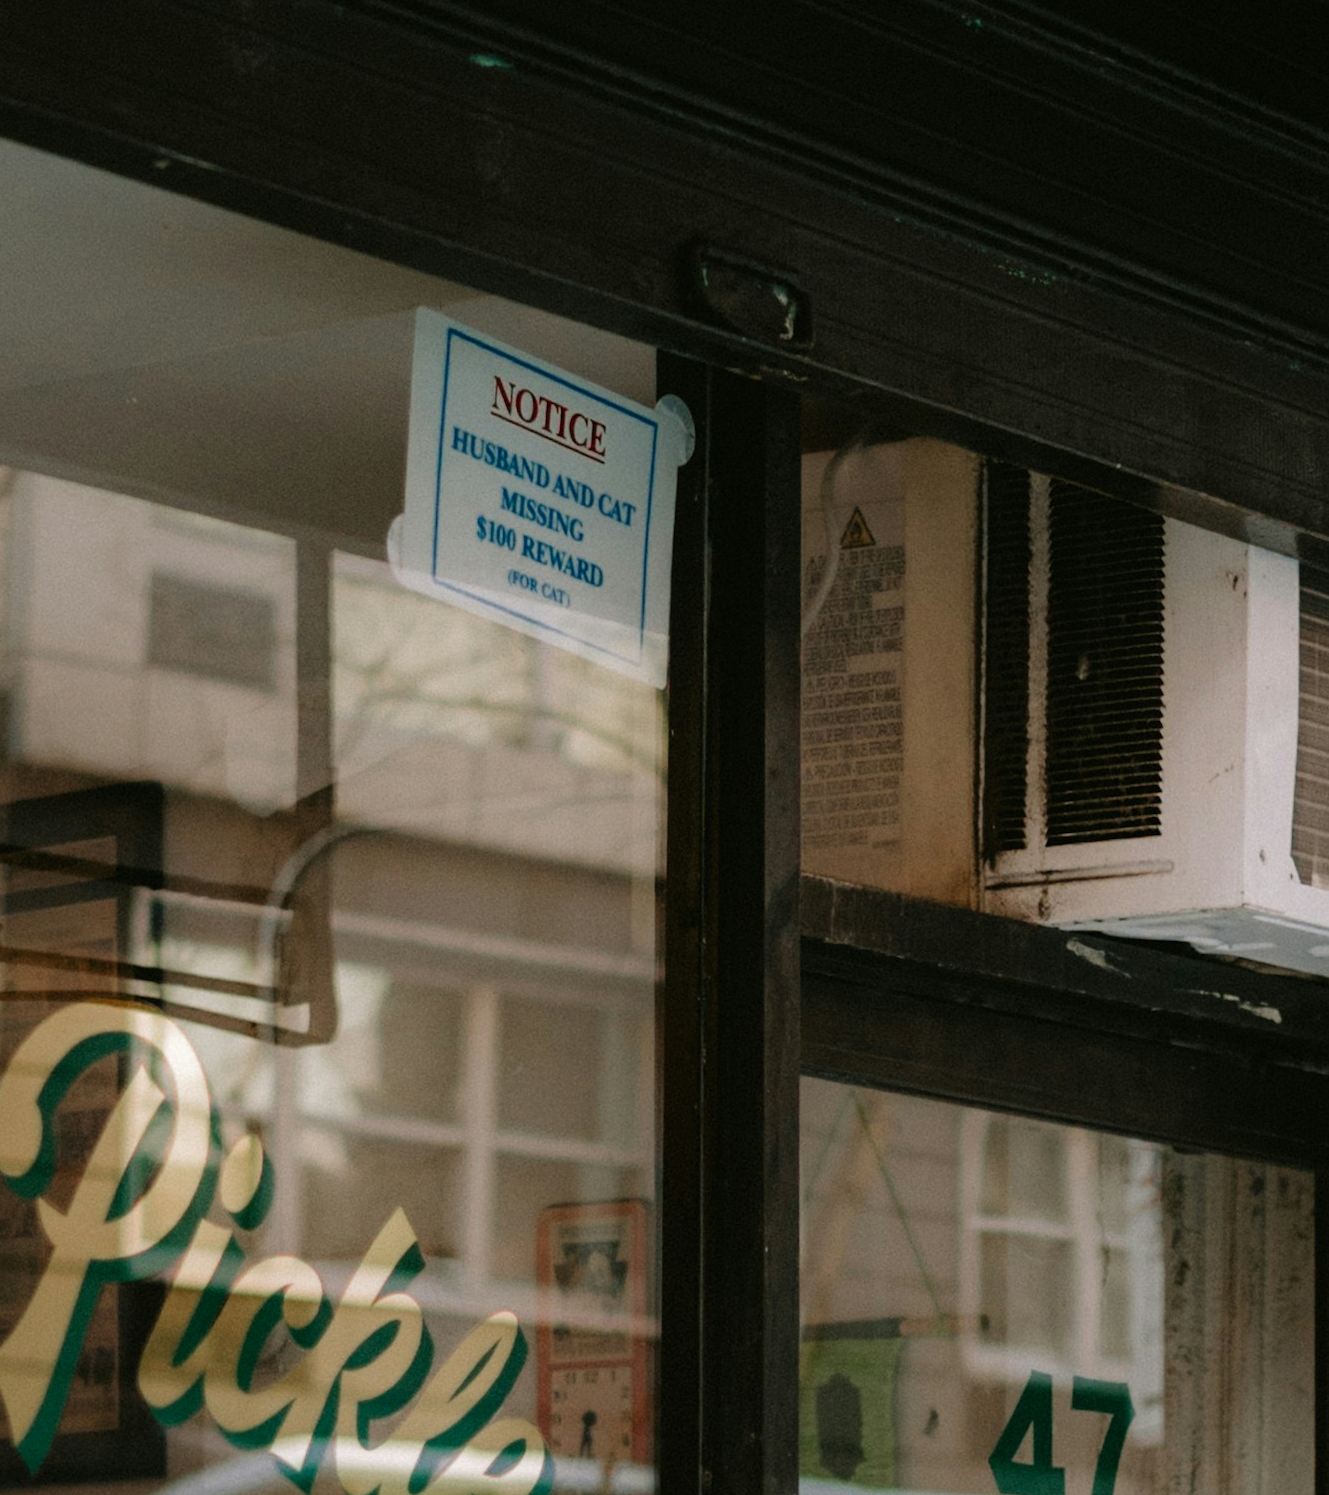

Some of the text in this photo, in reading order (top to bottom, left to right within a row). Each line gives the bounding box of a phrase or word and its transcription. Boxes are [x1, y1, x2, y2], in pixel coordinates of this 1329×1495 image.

[491, 376, 607, 458] NOTICE
[452, 426, 636, 527] HUSBAND AND CAT
[500, 487, 585, 542] MISSING
[476, 515, 604, 588] $100 REWARD
[507, 569, 539, 594] (FOR
